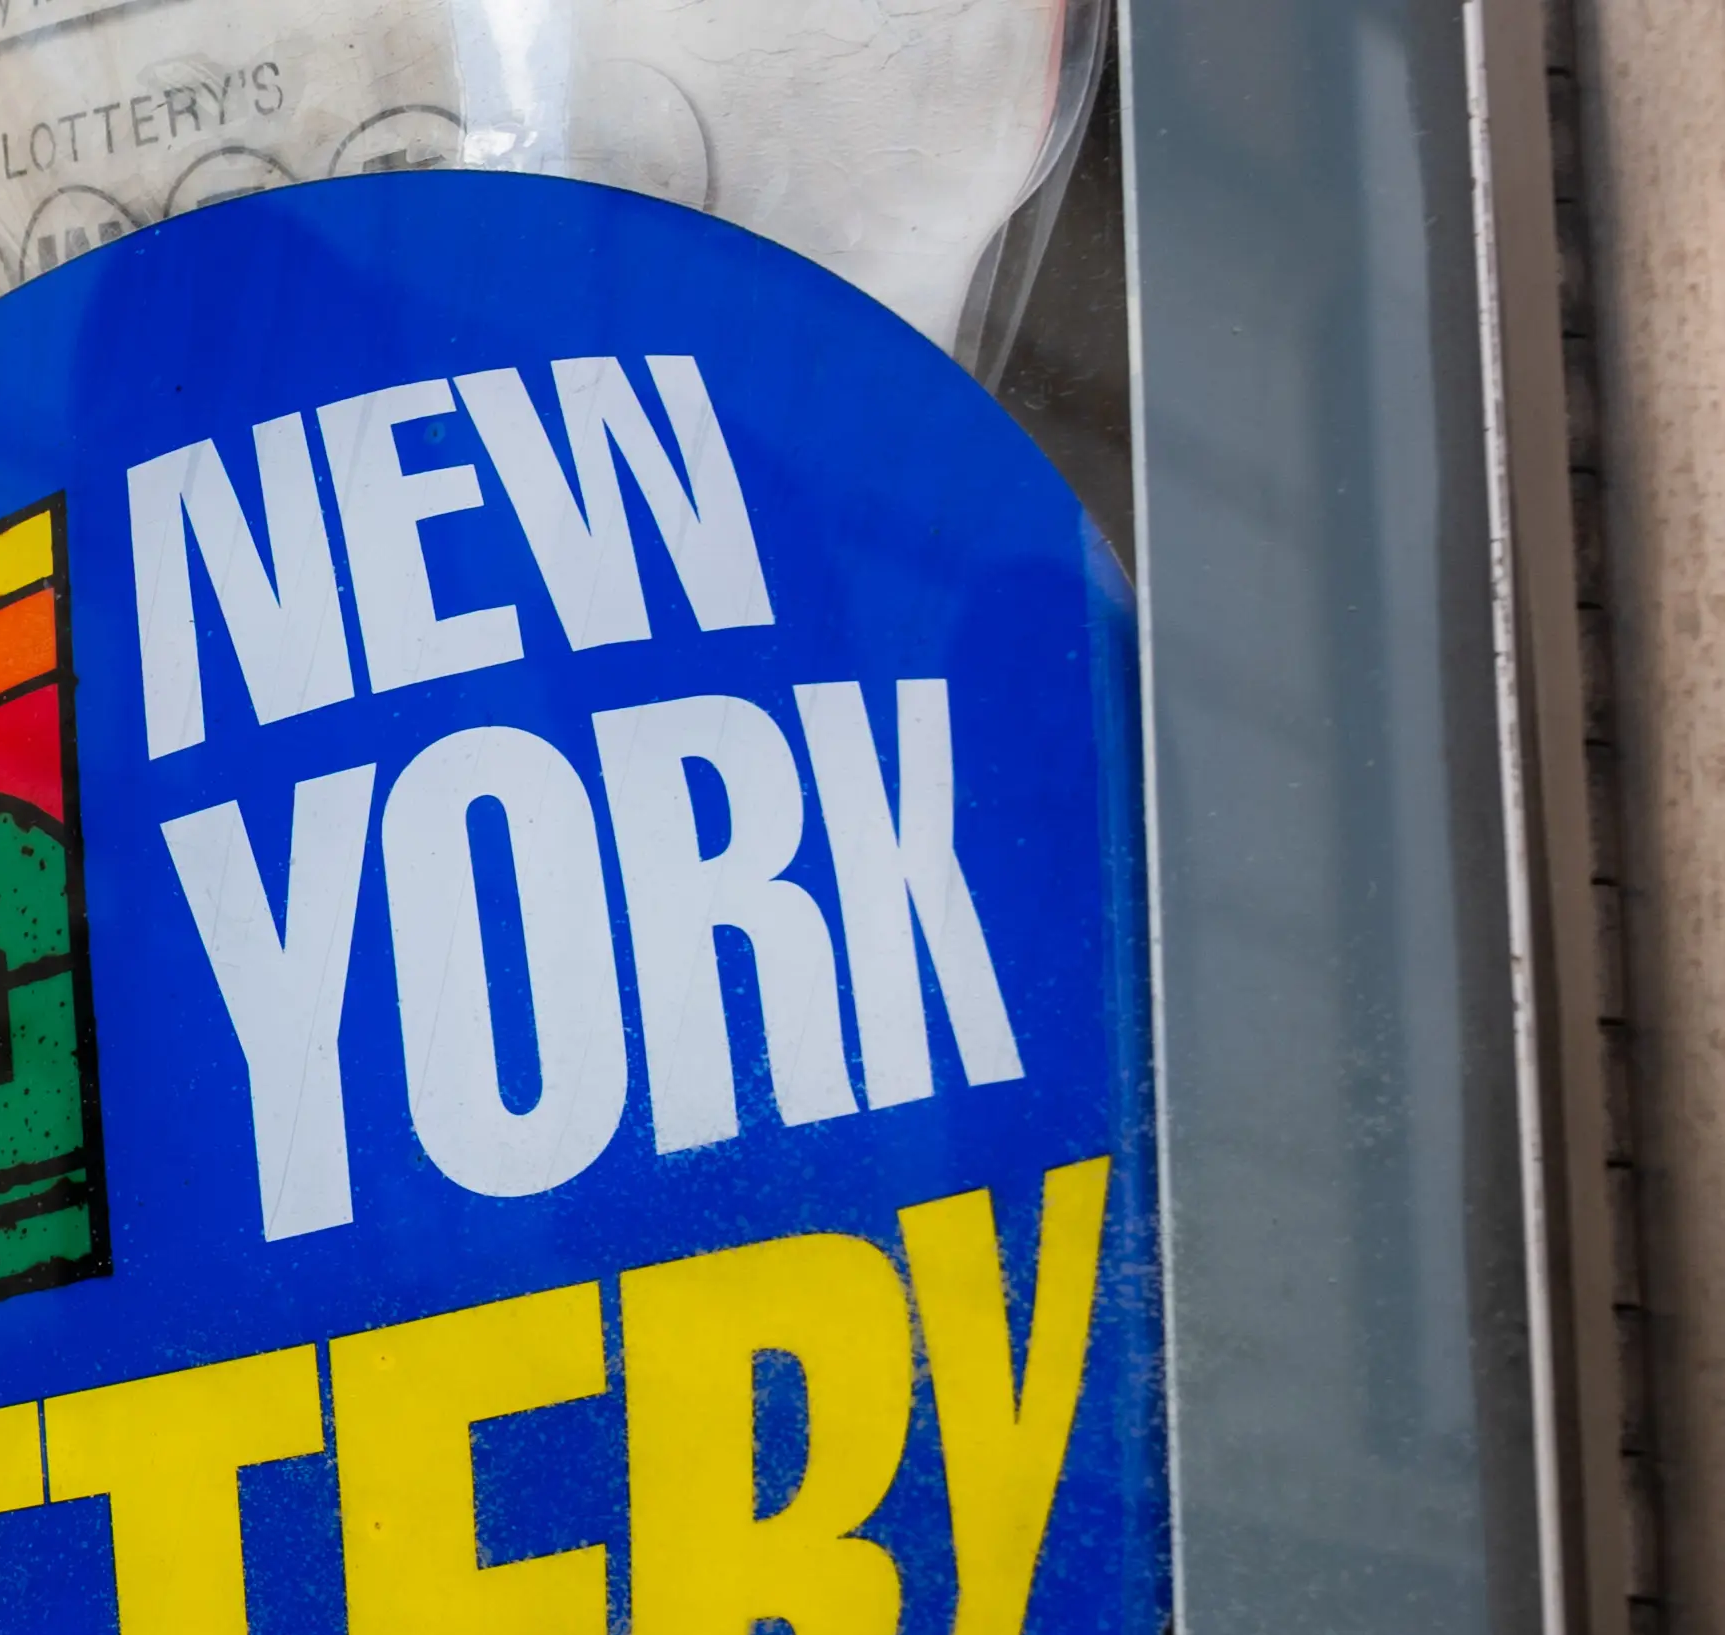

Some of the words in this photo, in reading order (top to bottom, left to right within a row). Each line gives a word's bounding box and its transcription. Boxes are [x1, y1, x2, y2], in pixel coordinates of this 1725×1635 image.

[1, 62, 284, 180] LOTTERY'S
[127, 355, 775, 761] NEW
[159, 678, 1024, 1243] YORK
